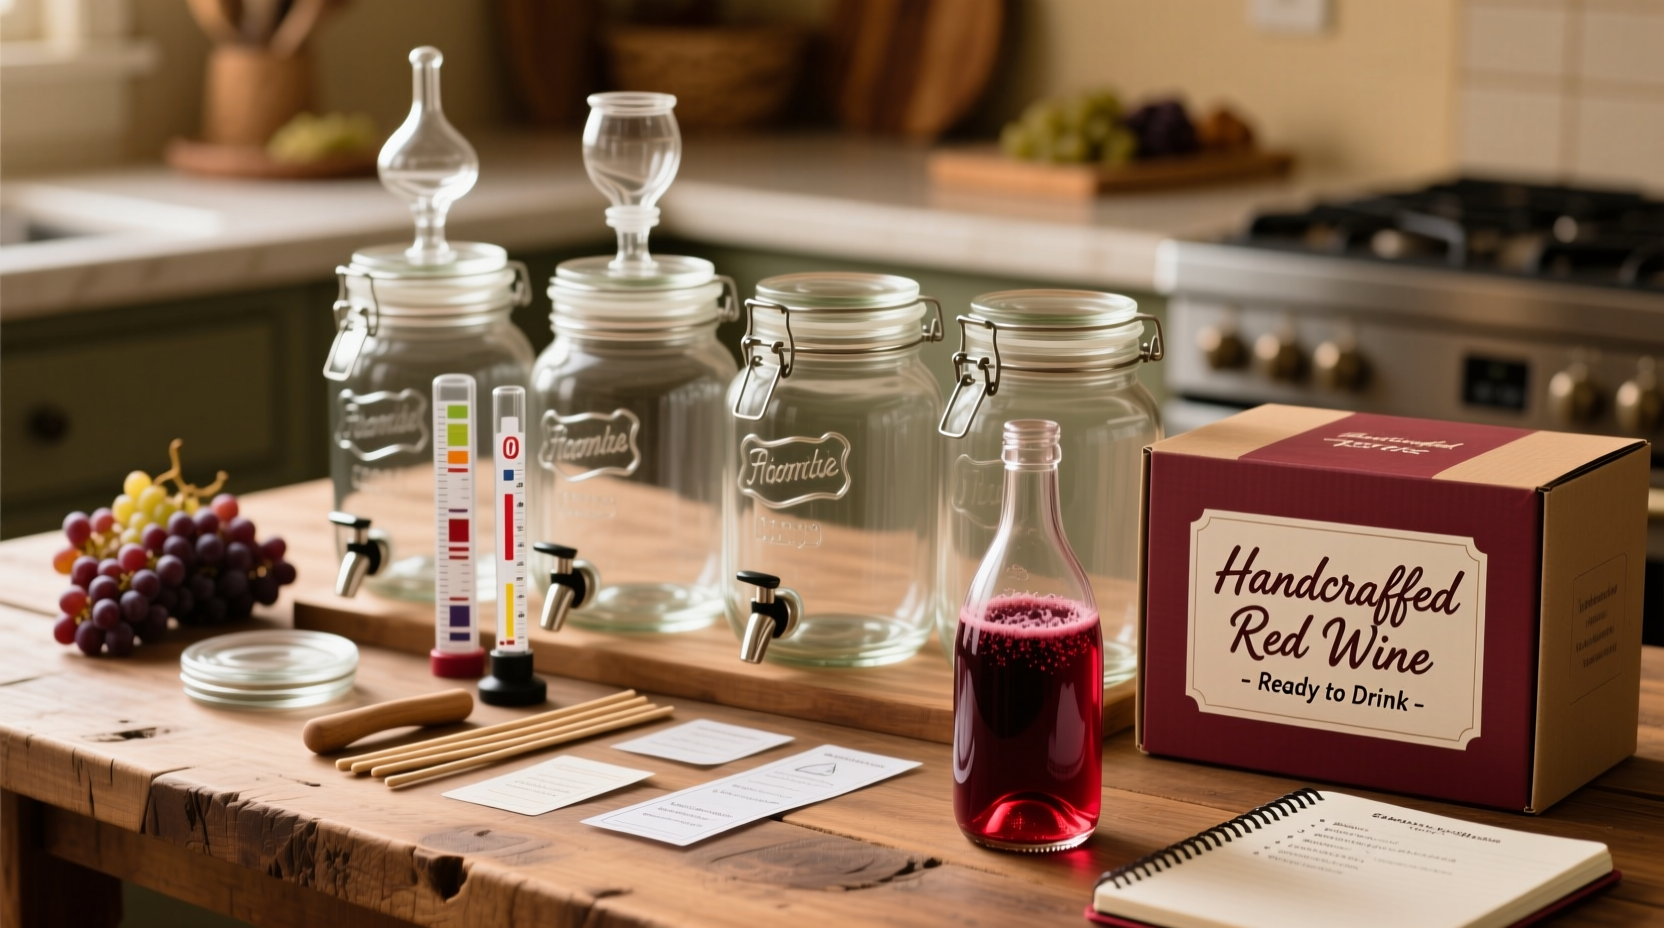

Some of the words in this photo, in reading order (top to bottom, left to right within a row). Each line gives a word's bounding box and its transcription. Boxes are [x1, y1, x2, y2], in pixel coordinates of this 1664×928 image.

[1230, 605, 1314, 662] Red
[1322, 617, 1434, 675] Wine
[1258, 671, 1320, 704] Ready
[1325, 682, 1346, 702] to
[1352, 684, 1409, 711] Drink
